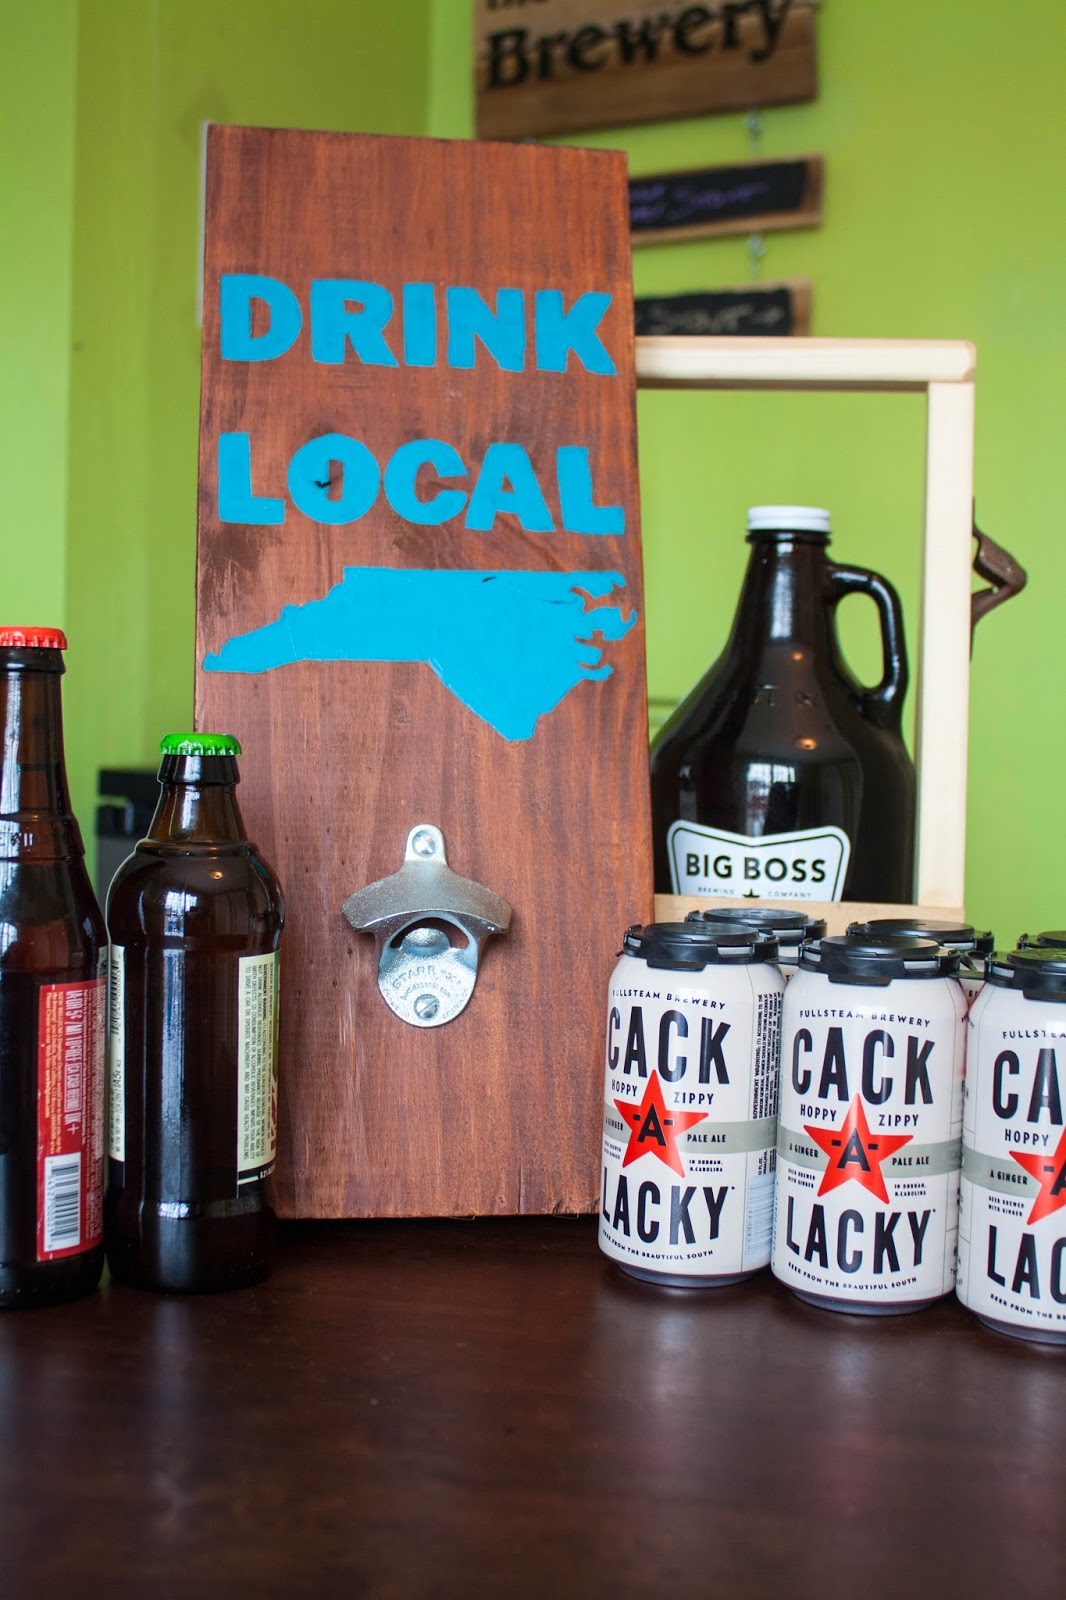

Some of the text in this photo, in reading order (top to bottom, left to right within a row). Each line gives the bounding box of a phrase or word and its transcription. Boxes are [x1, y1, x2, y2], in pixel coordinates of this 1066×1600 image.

[488, 0, 791, 89] Brewery
[220, 274, 617, 375] DRINK
[218, 432, 625, 534] LOCAL
[686, 853, 826, 883] BIG BOSS
[698, 887, 735, 895] BREWING
[613, 989, 726, 1010] FULLSTEAM BREWERY
[800, 1009, 931, 1028] FULLSTEAM BREWERY
[608, 1006, 732, 1084] CACK
[792, 1027, 935, 1105] CACK
[612, 1079, 714, 1105] HOPPY ZIPPY
[993, 1048, 1064, 1125] CA
[609, 1118, 624, 1131] GINGER
[800, 1104, 919, 1126] HOPPY ZIPPY
[687, 1134, 726, 1143] PALE ALE
[1004, 1128, 1050, 1146] HOPPY
[794, 1145, 818, 1158] GINGER
[892, 1156, 930, 1166] PALE ALE
[990, 1169, 1028, 1186] A GINGER
[602, 1166, 729, 1246] LACKY
[1002, 1199, 1024, 1208] BREWED
[1002, 1208, 1022, 1217] GINGER
[786, 1195, 931, 1275] LACKY
[612, 1238, 626, 1251] FROM
[628, 1247, 640, 1256] THE
[642, 1252, 684, 1260] BEAUTIFUL
[687, 1250, 714, 1260] SOUTH
[788, 1262, 802, 1274] BEER
[804, 1271, 822, 1284] FROM
[825, 1279, 840, 1288] THE
[892, 1276, 918, 1288] SOUTH
[991, 1293, 1008, 1306] BEER
[1010, 1304, 1033, 1315] FROM
[1037, 1311, 1052, 1319] THE
